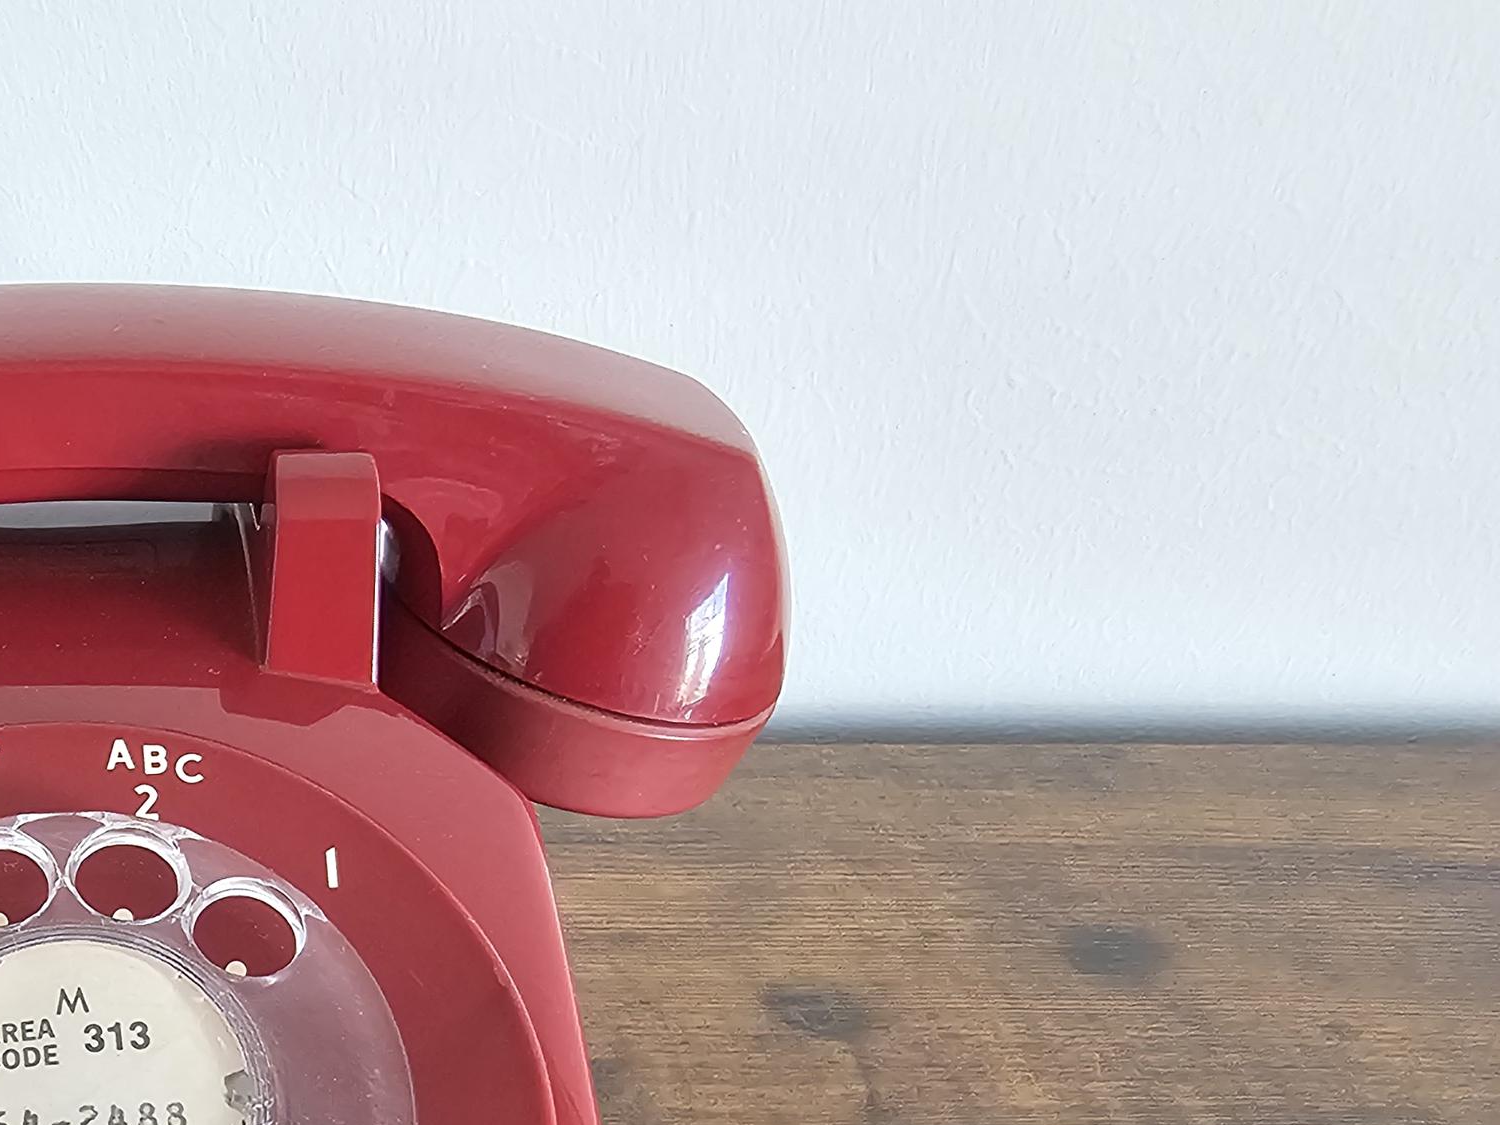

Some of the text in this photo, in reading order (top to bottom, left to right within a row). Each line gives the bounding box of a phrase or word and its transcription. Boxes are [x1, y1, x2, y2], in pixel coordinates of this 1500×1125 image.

[106, 738, 205, 785] ABC
[134, 785, 160, 821] 2
[56, 986, 90, 1016] M
[83, 1020, 151, 1053] 313
